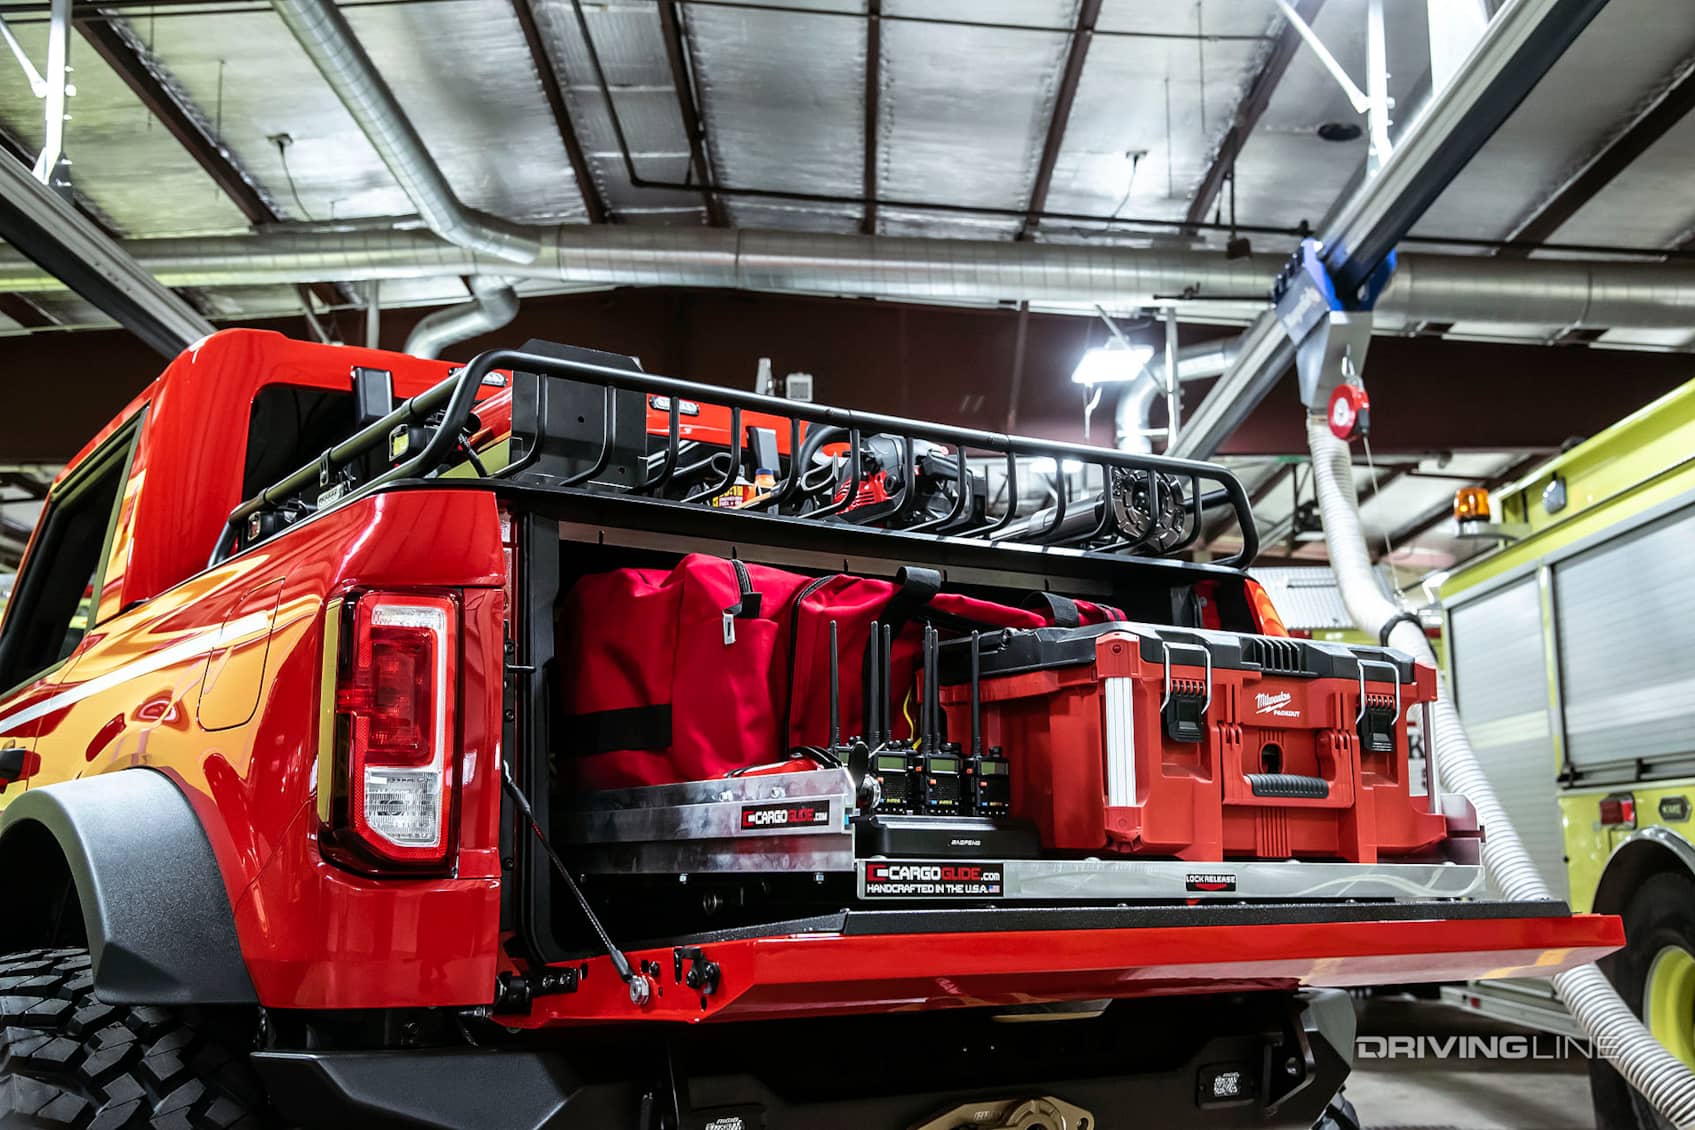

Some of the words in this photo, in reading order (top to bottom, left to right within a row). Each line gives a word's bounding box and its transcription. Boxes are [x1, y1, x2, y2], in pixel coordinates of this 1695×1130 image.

[1186, 875, 1204, 883] LOCK
[1204, 875, 1236, 883] RELEASE
[866, 884, 935, 893] HANDCRAFTED
[935, 884, 944, 893] IN
[945, 884, 964, 893] THE
